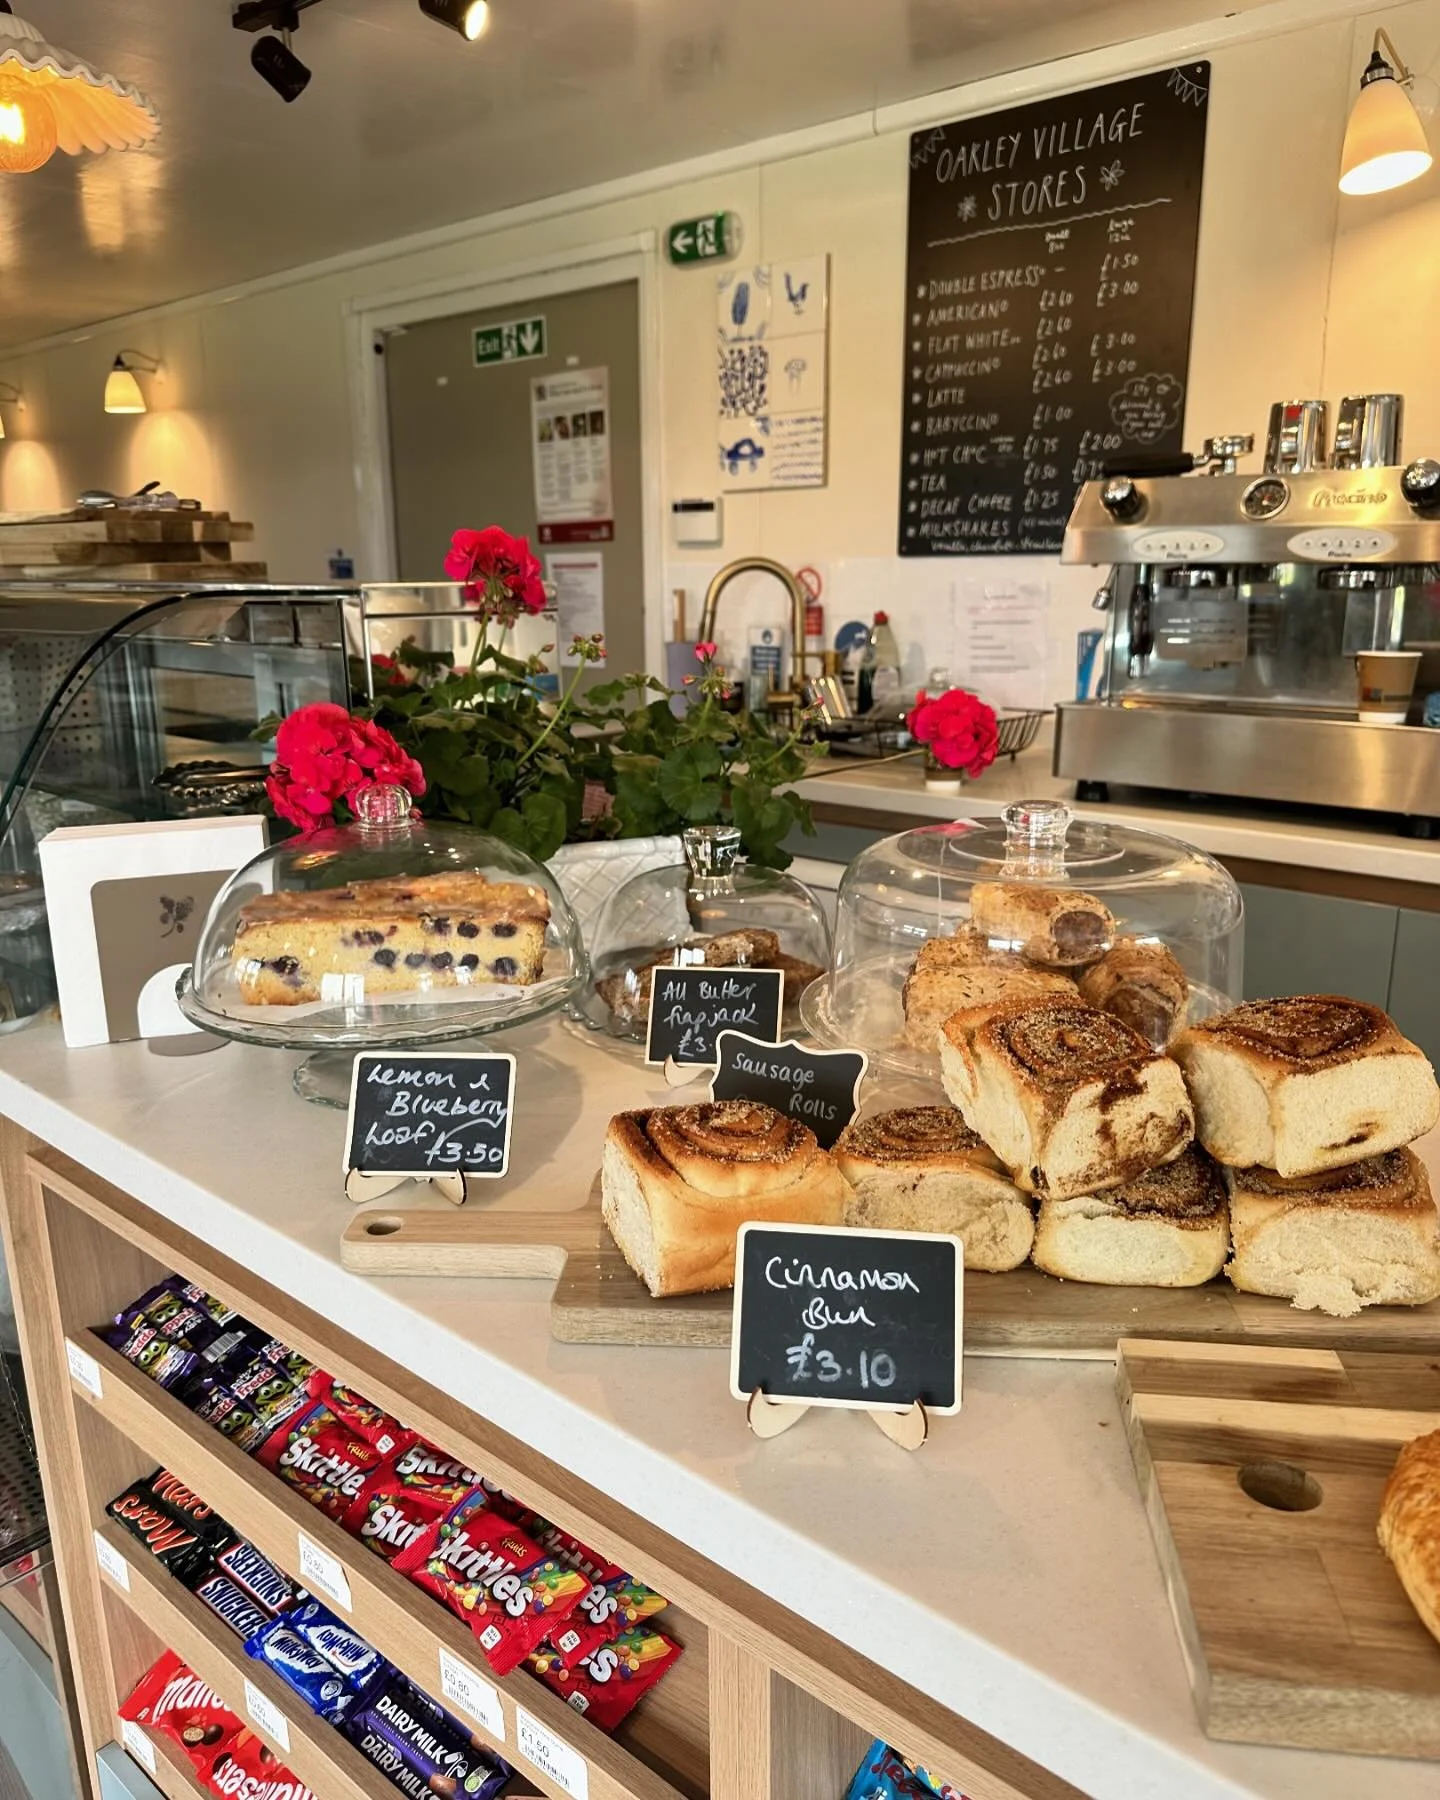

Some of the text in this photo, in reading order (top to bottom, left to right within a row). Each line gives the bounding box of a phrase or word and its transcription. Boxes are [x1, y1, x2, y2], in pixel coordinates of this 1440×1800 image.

[936, 102, 1145, 184] OAKLEY VILLAGE
[987, 164, 1088, 221] STORES
[929, 275, 976, 300] DOUBLE
[927, 300, 1010, 327] AMERICANO
[928, 334, 961, 356] FLAT
[927, 388, 966, 409] LATTE
[923, 446, 951, 466] HOT
[920, 474, 947, 493] TEA
[920, 496, 960, 518] DECAF
[919, 520, 1011, 538] MILKSHAKES
[661, 978, 757, 1002] All Butter
[678, 1028, 713, 1057] £3.
[367, 1063, 456, 1089] Lemon
[731, 1052, 815, 1091] Sausage
[789, 1094, 838, 1120] Rolls
[365, 1120, 436, 1146] Loaf
[425, 1131, 503, 1166] £3.50
[765, 1256, 920, 1294] Cinnamon
[801, 1297, 876, 1330] Bun
[785, 1332, 897, 1389] £3.10
[280, 1437, 367, 1499] Skittle
[223, 1544, 291, 1608] SNICKERS
[376, 1695, 448, 1765] DAIRY MILK
[360, 1734, 404, 1772] DAIRY
